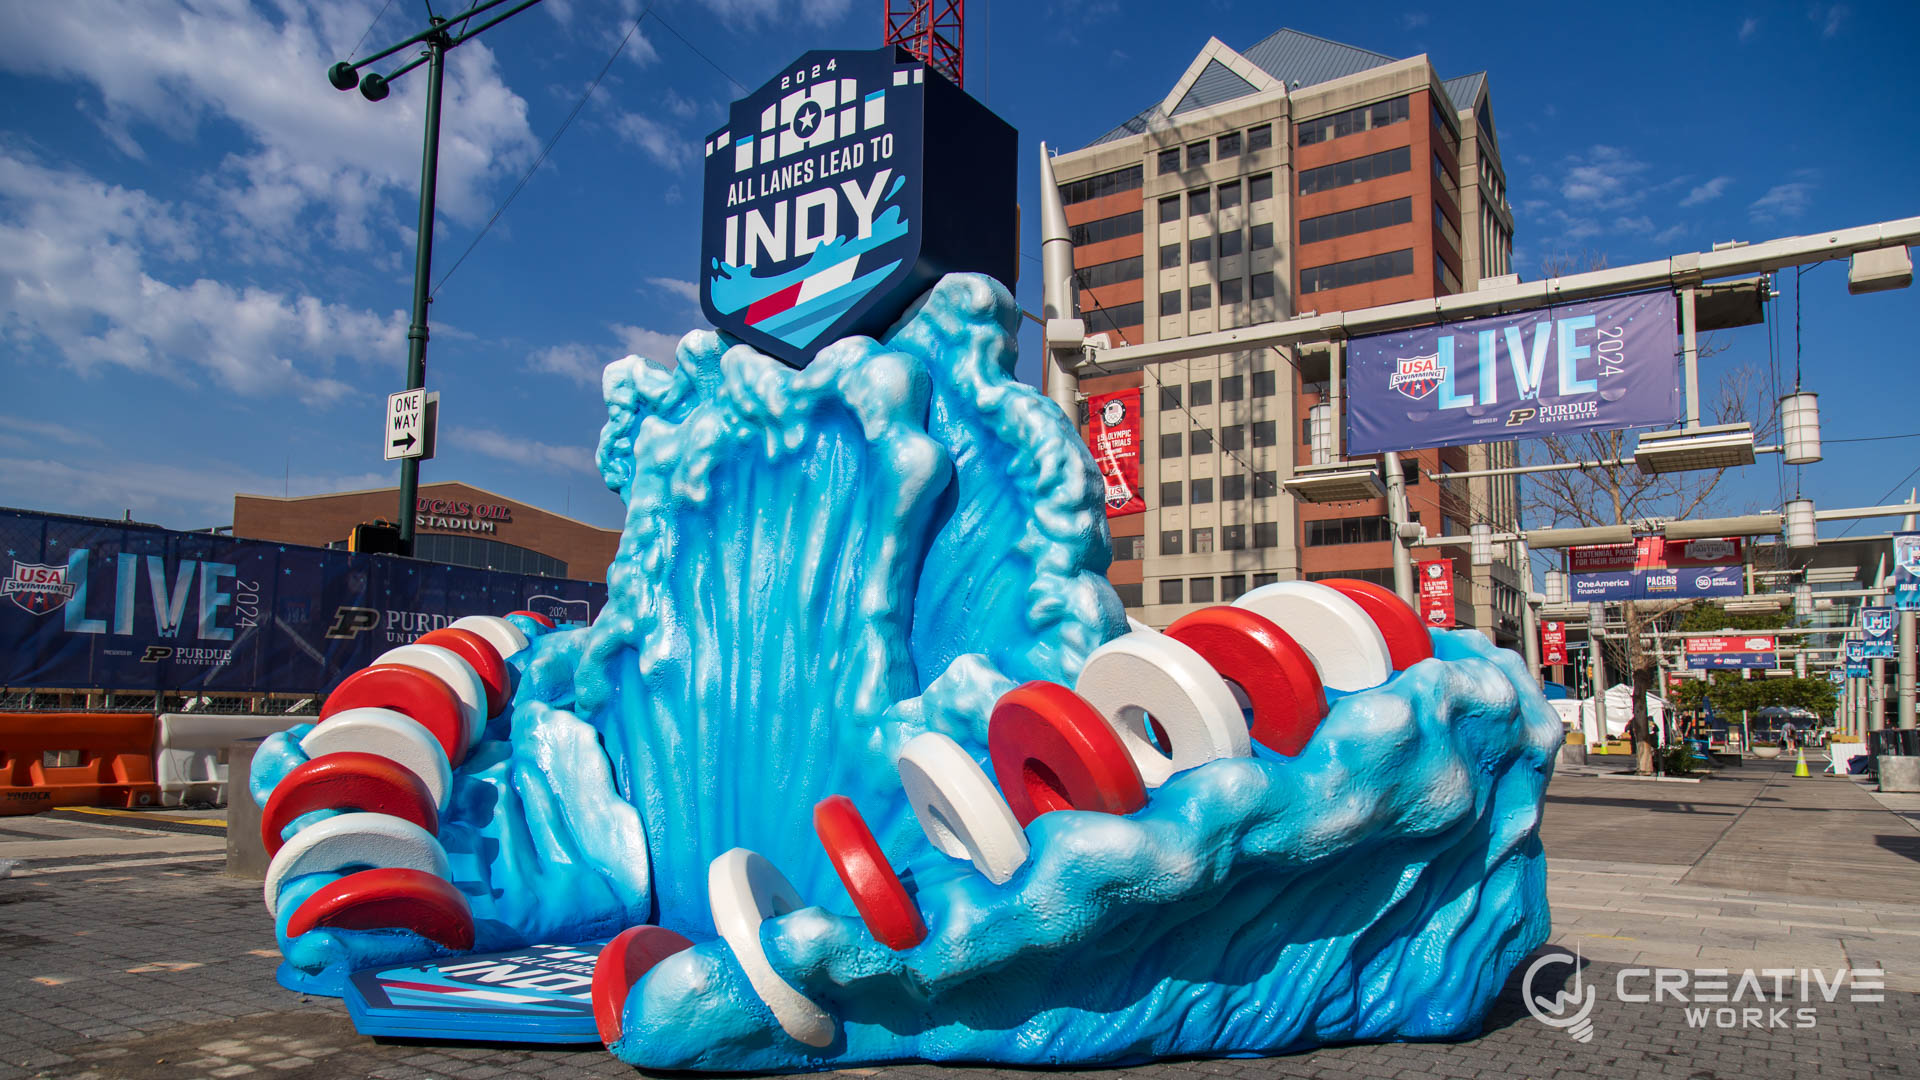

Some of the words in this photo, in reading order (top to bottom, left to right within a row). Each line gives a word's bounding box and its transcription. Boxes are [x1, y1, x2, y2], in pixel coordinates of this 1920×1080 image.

[781, 58, 837, 89] 2024
[727, 178, 756, 207] ALL
[761, 159, 814, 196] LANES
[820, 143, 864, 178] LEAD
[871, 133, 893, 162] TO
[725, 168, 893, 269] INDY
[1597, 326, 1625, 377] 2024
[1402, 360, 1433, 374] USA
[1438, 314, 1598, 410] LIVE
[1394, 370, 1441, 383] SWIMMING
[395, 395, 419, 413] ONE
[1539, 401, 1598, 417] PURDUE
[394, 413, 419, 430] WAY
[1539, 412, 1599, 424] UNIVERSITY
[1108, 429, 1132, 440] OLYMPIC
[1112, 438, 1132, 448] TRIALS
[416, 497, 472, 516] UCAS
[474, 504, 510, 520] OIL
[416, 515, 494, 532] STADIUM
[1575, 549, 1614, 559] CENTENNIAL
[1615, 547, 1649, 556] PARTNERS
[1575, 558, 1588, 566] FOR
[1589, 557, 1607, 565] THEIR
[1609, 555, 1639, 564] SUPPORT
[19, 568, 62, 585] USA
[1646, 575, 1677, 586] PACERS
[8, 581, 70, 594] SWIMMING
[1577, 579, 1630, 589] OneAmerica
[1577, 587, 1606, 595] Financial
[1900, 583, 1917, 591] JUNE
[64, 548, 237, 641] LIVE
[235, 580, 260, 629] 2024
[549, 606, 568, 617] 2024
[386, 610, 460, 632] PURD
[176, 647, 232, 660] PURDUE
[176, 658, 232, 666] UNIVERSITY
[500, 956, 547, 965] ALL
[438, 961, 593, 999] IND
